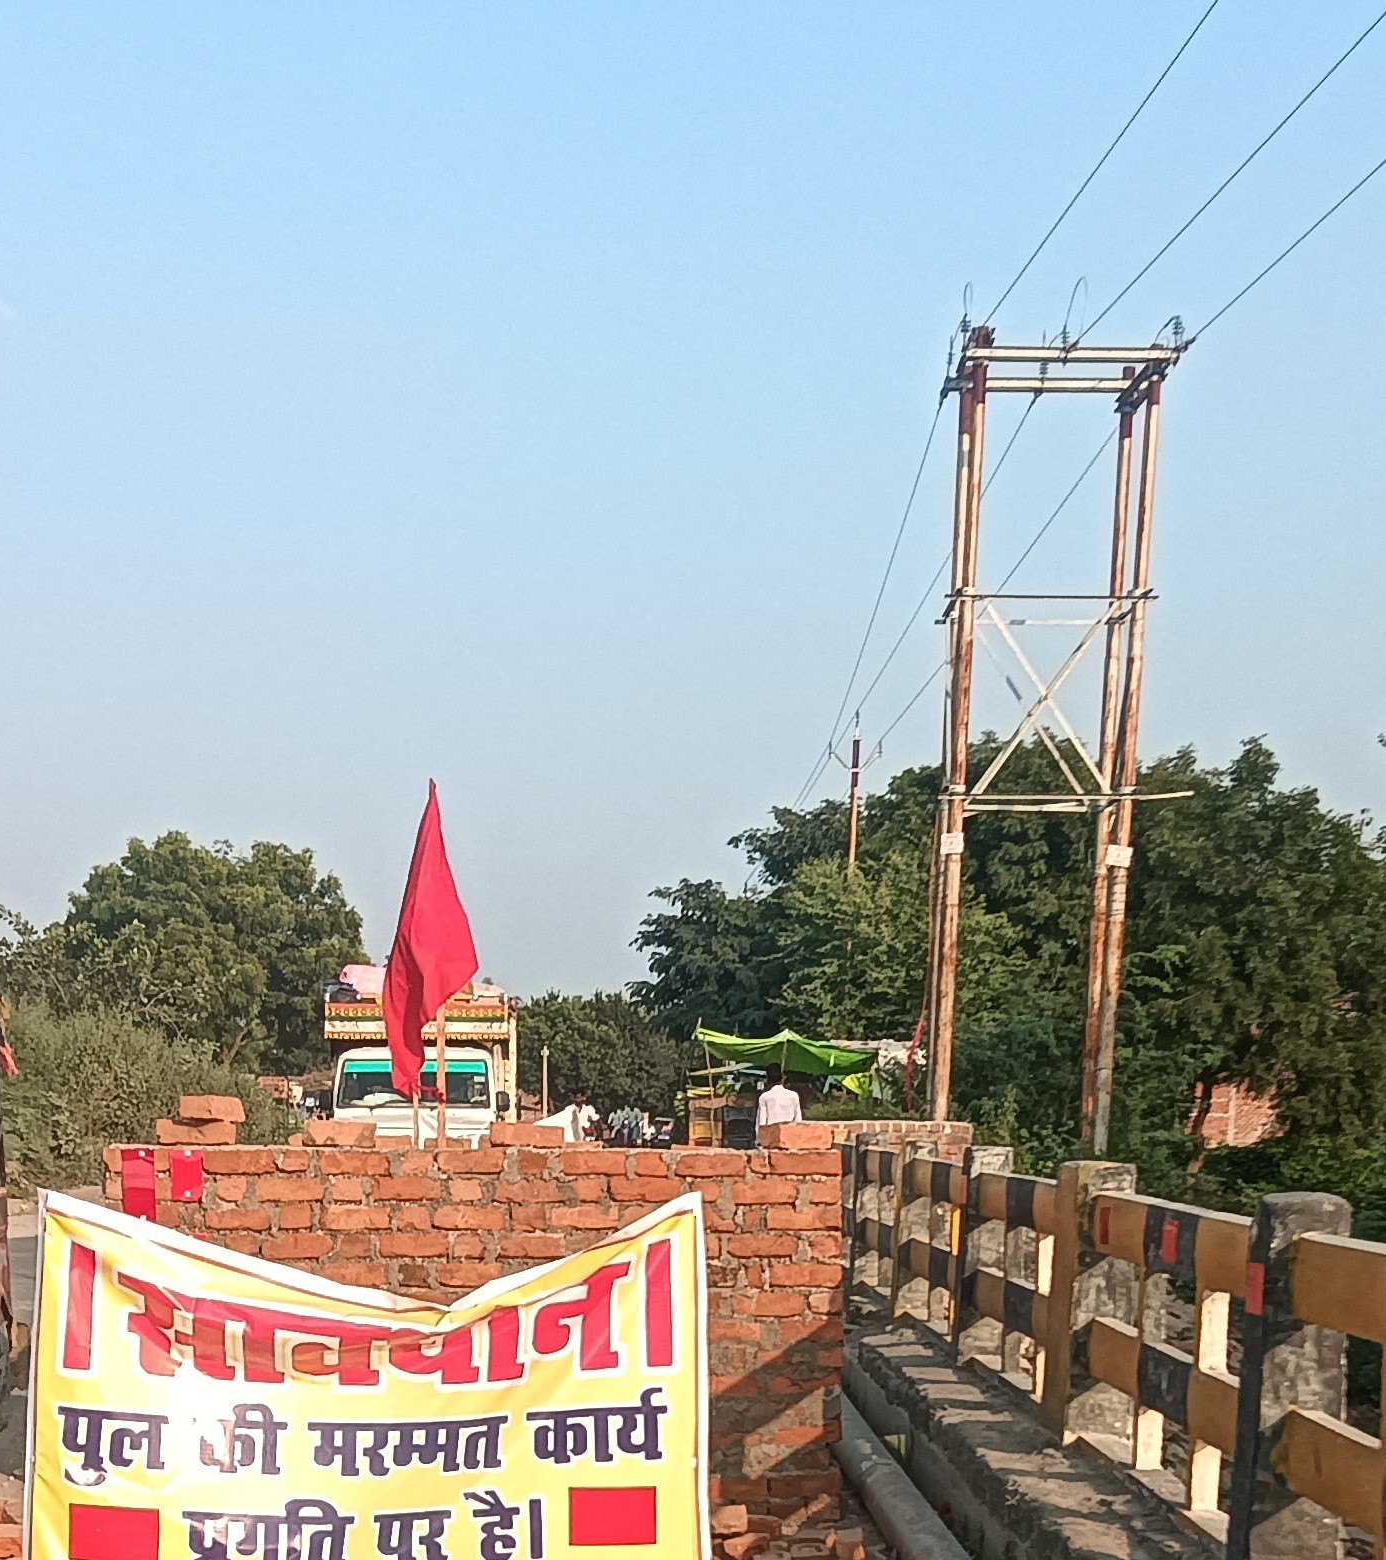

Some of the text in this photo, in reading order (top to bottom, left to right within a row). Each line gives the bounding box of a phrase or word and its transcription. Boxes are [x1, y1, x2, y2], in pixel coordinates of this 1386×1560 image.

[58, 1387, 669, 1487] पुल की मरम्मत कार्य
